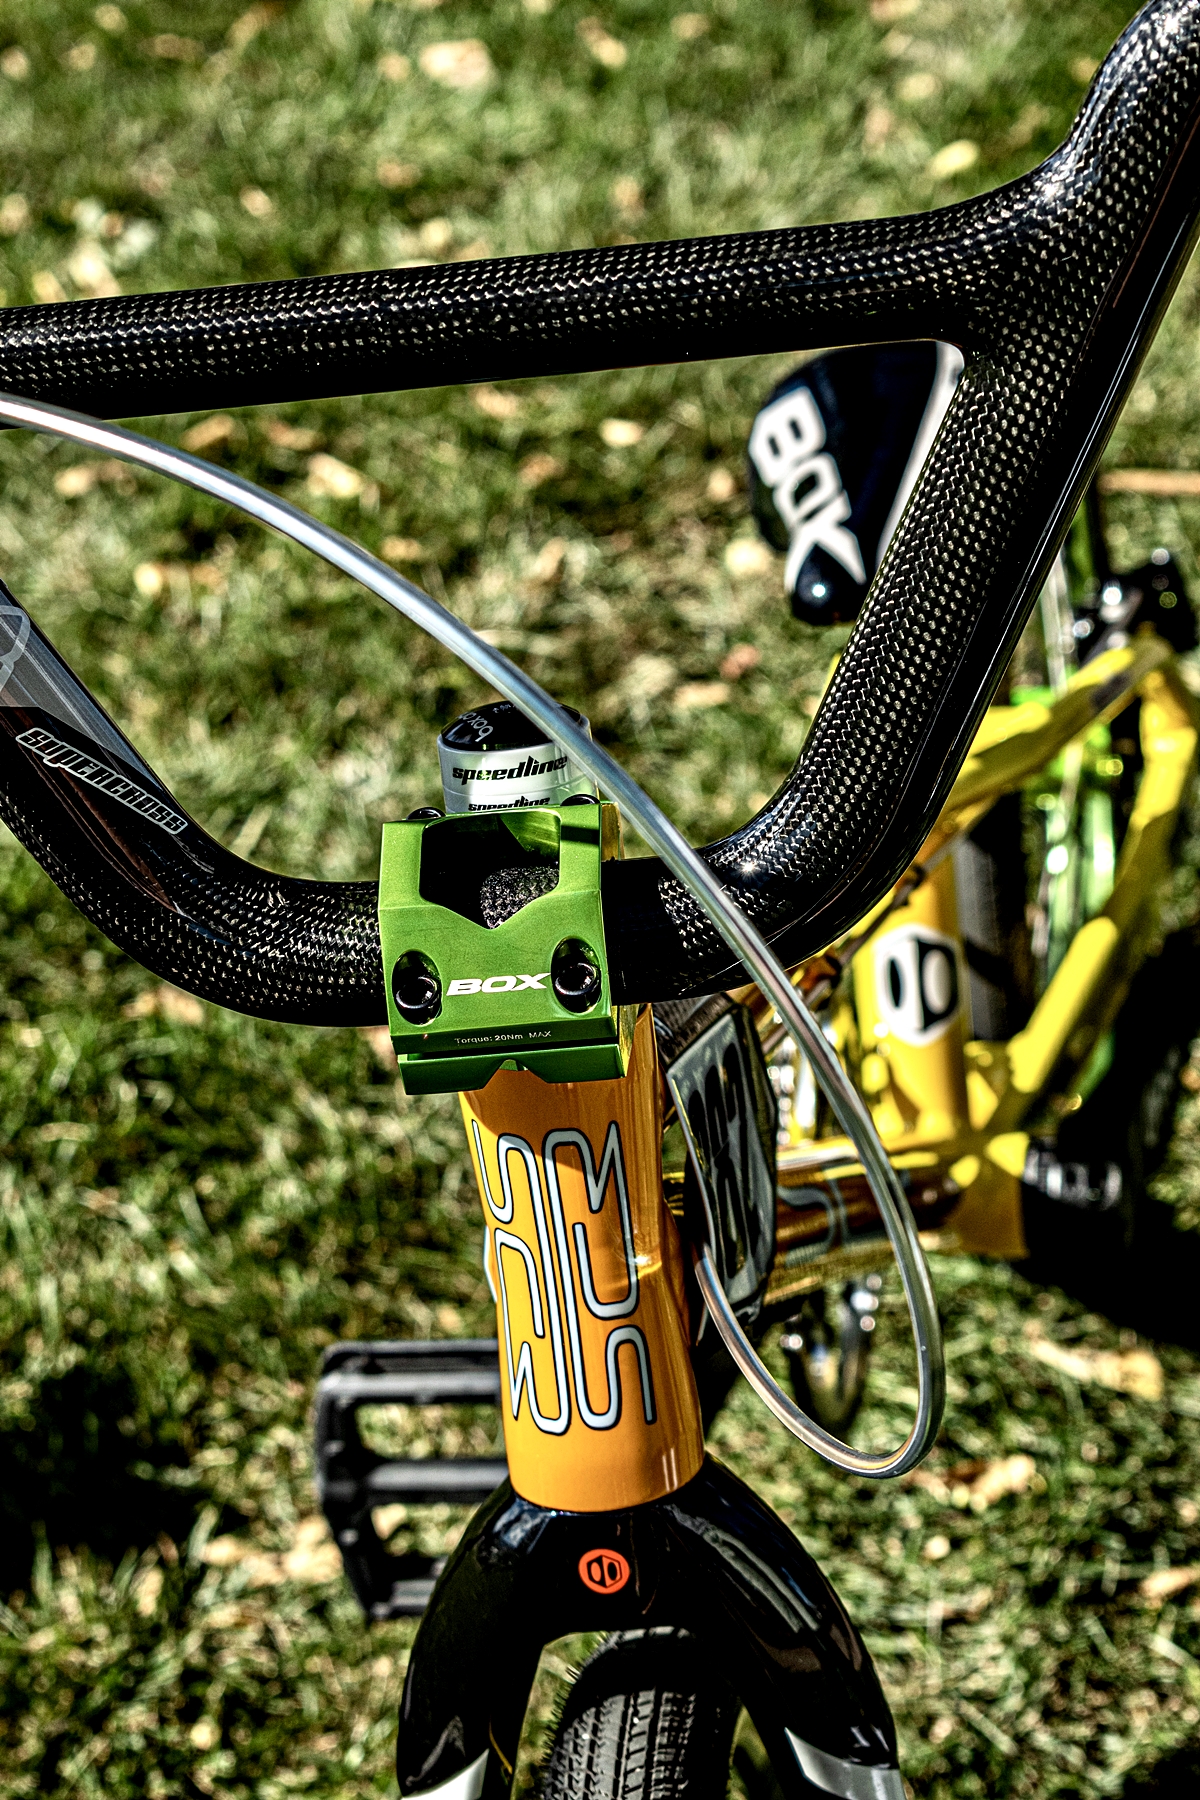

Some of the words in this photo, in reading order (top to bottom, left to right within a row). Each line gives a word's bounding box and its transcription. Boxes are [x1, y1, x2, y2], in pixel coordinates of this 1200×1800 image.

[748, 385, 867, 594] BOX
[452, 755, 568, 786] speedline
[446, 972, 551, 996] BOX
[454, 1035, 493, 1045] Torque:
[494, 1033, 524, 1041] 20Nm
[528, 1030, 552, 1039] MAX
